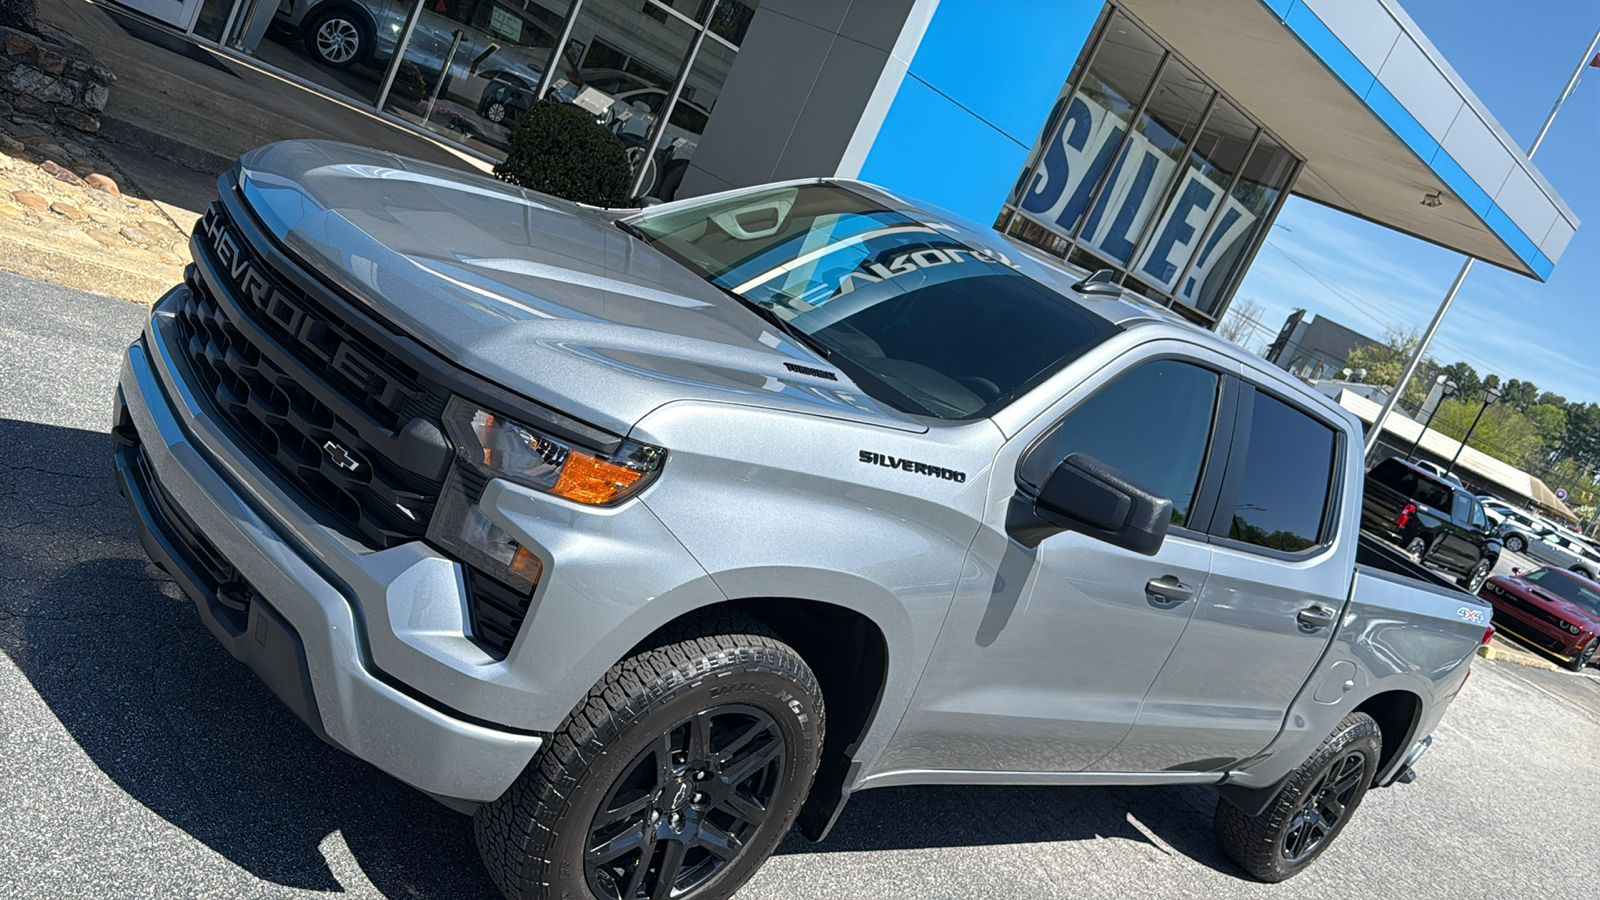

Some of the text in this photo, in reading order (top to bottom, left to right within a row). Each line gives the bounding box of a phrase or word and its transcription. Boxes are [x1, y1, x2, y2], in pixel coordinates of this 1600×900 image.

[1014, 96, 1242, 298] SALE!
[201, 203, 417, 416] CHEVROLET
[783, 362, 838, 381] TURBOMAX
[859, 450, 966, 483] SILVERADO
